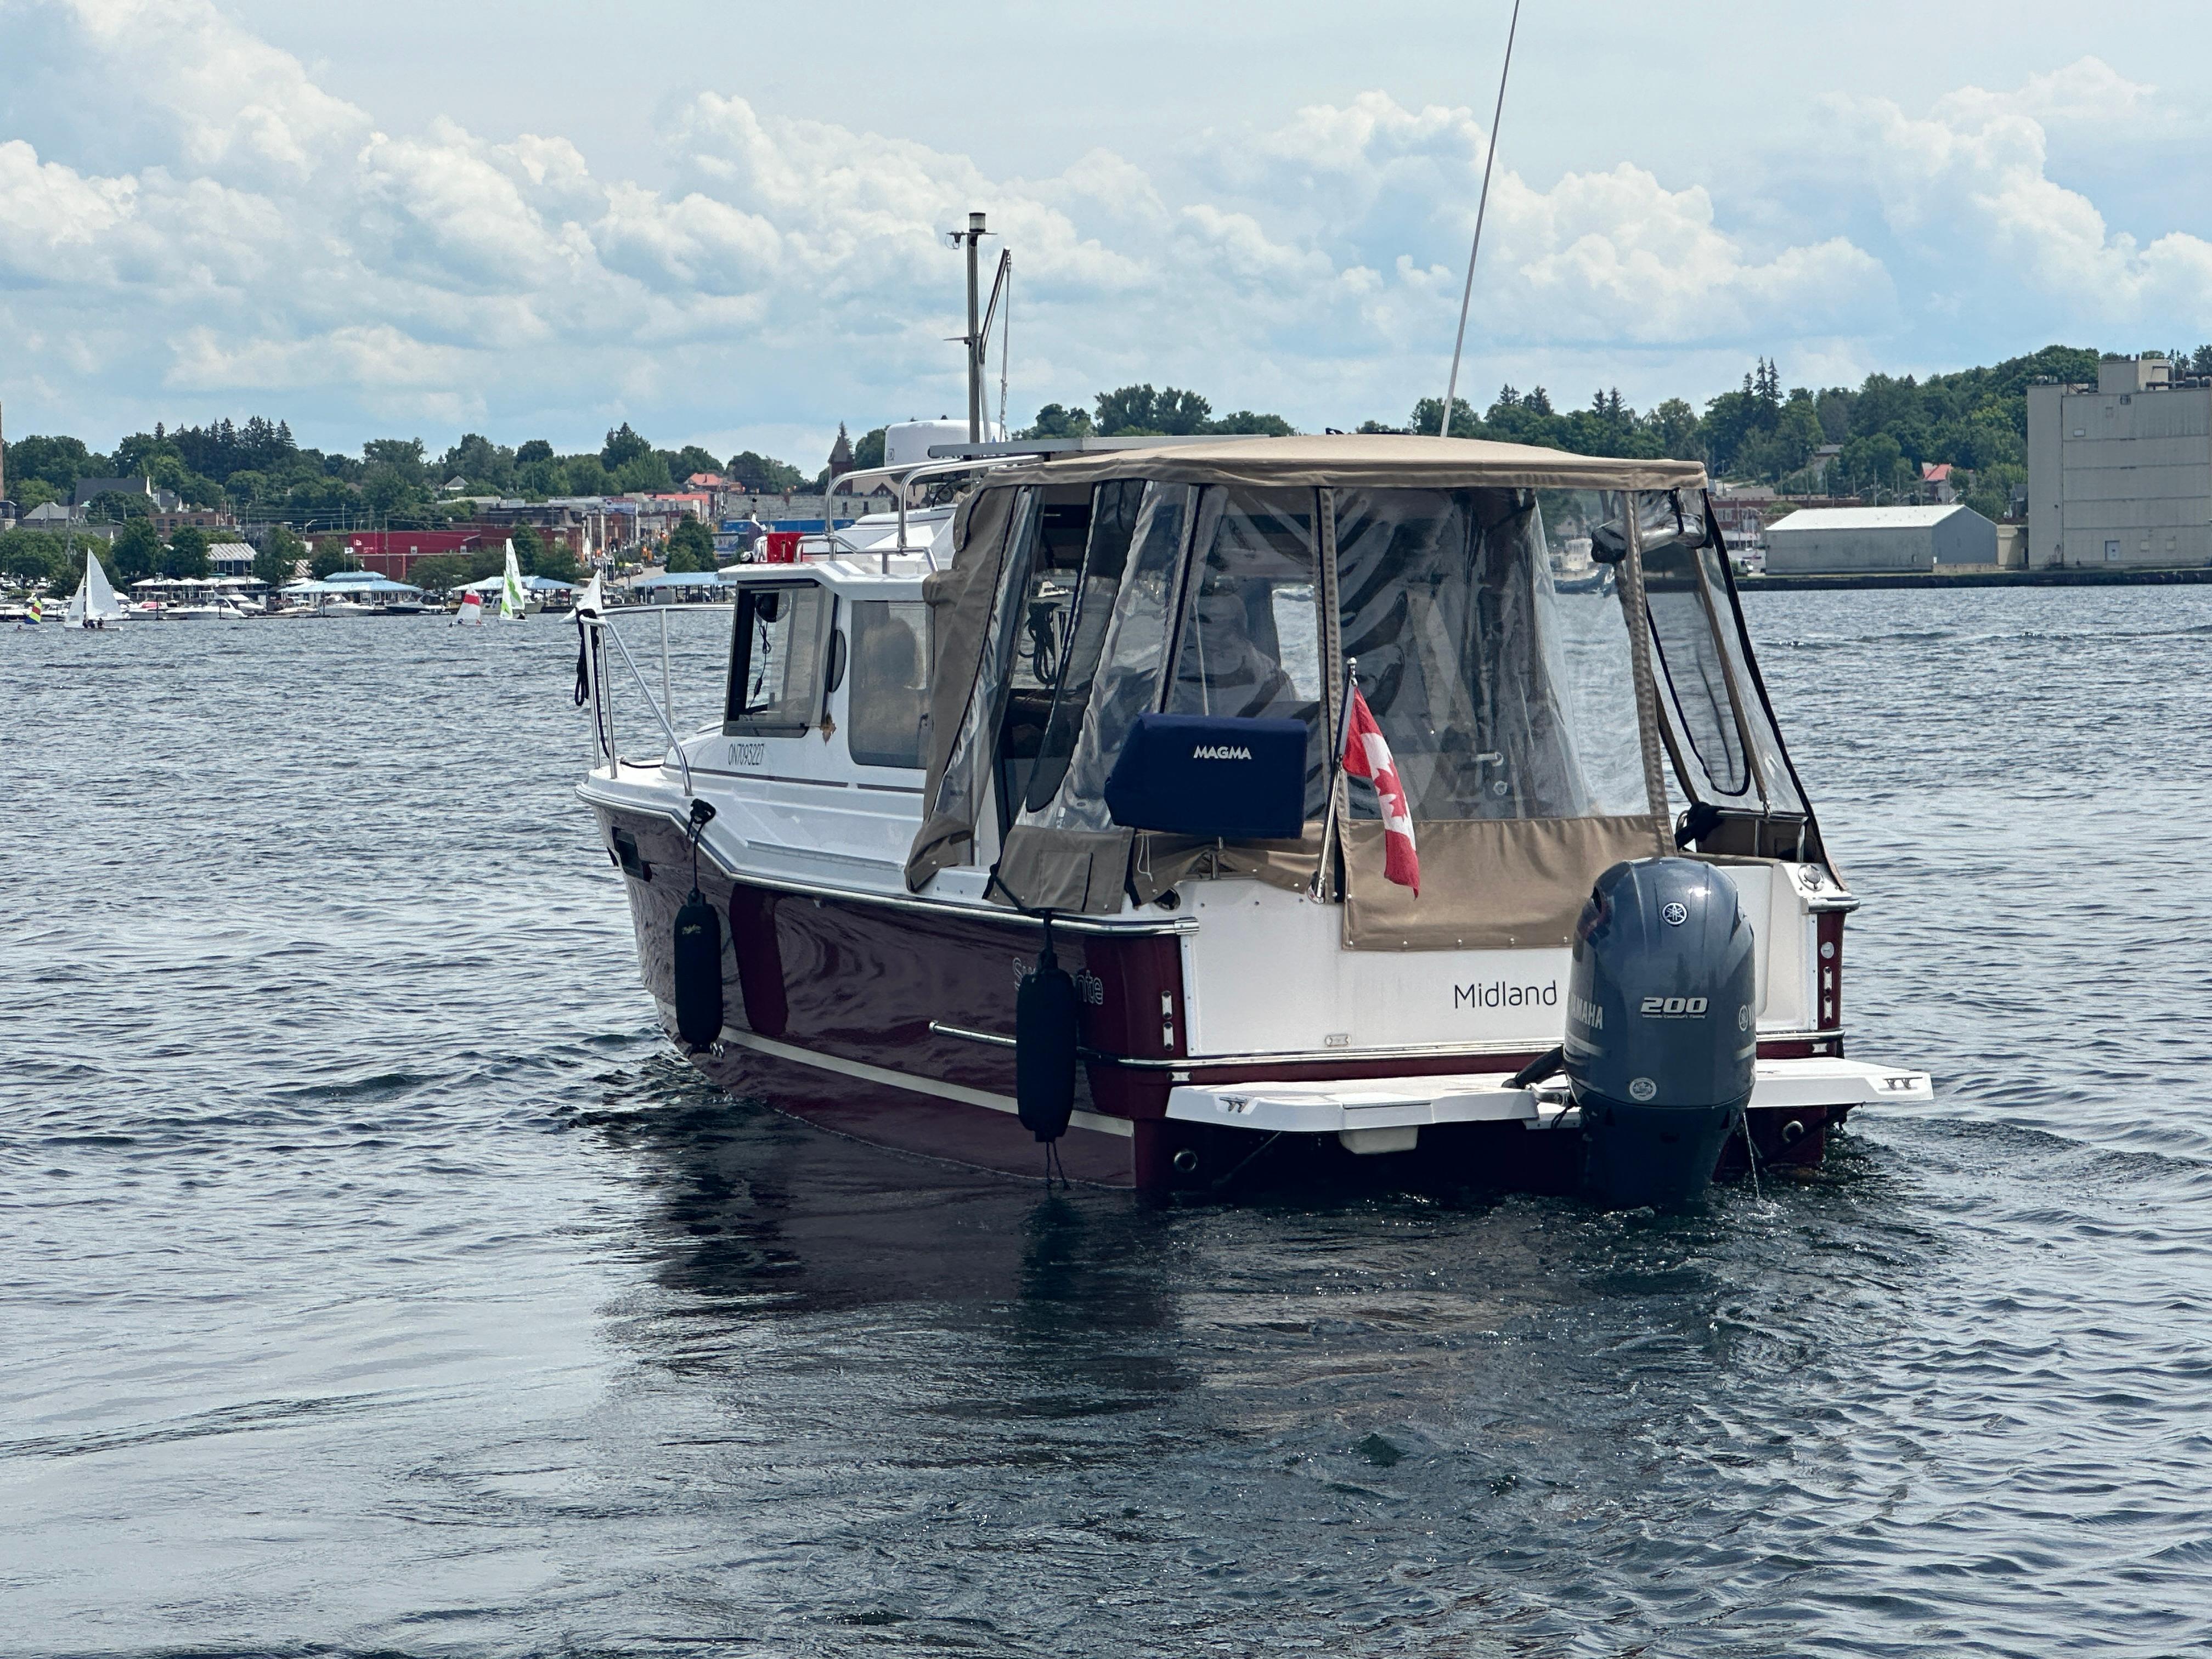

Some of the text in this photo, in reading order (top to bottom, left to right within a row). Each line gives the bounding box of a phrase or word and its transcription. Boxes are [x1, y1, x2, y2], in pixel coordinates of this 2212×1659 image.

[1193, 745, 1252, 759] MAGMA
[1454, 980, 1557, 1009] Midland
[1640, 997, 1708, 1013] 200
[1569, 994, 1603, 1030] AMAHA
